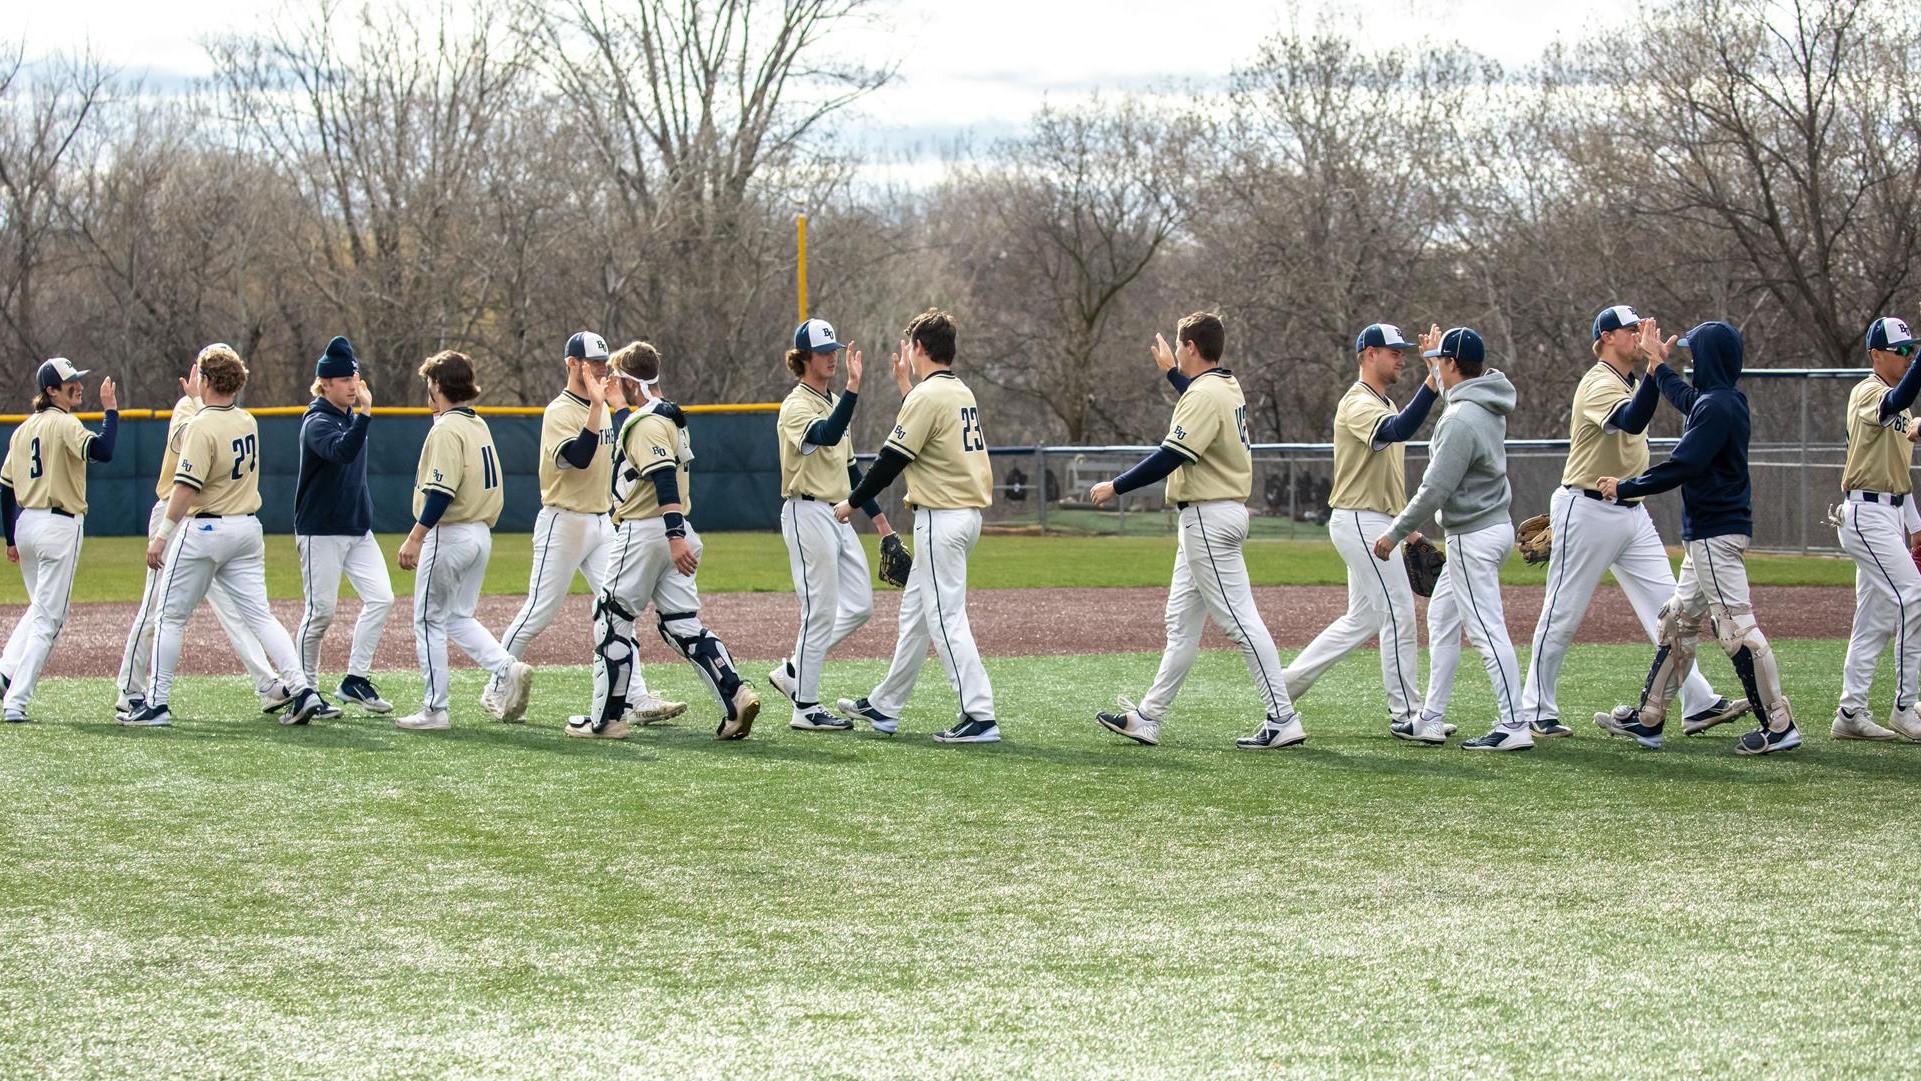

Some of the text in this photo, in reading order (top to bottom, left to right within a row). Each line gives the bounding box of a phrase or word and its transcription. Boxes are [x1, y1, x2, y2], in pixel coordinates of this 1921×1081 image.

[822, 327, 834, 340] BU
[1898, 323, 1910, 336] BU
[597, 340, 608, 353] BU
[895, 425, 906, 440] BU
[961, 407, 984, 452] 23
[1174, 426, 1186, 441] BU
[30, 436, 43, 479] 3
[231, 434, 256, 480] 27
[652, 446, 666, 457] BU
[182, 458, 193, 473] BU
[481, 445, 497, 490] 11
[433, 468, 444, 482] BU
